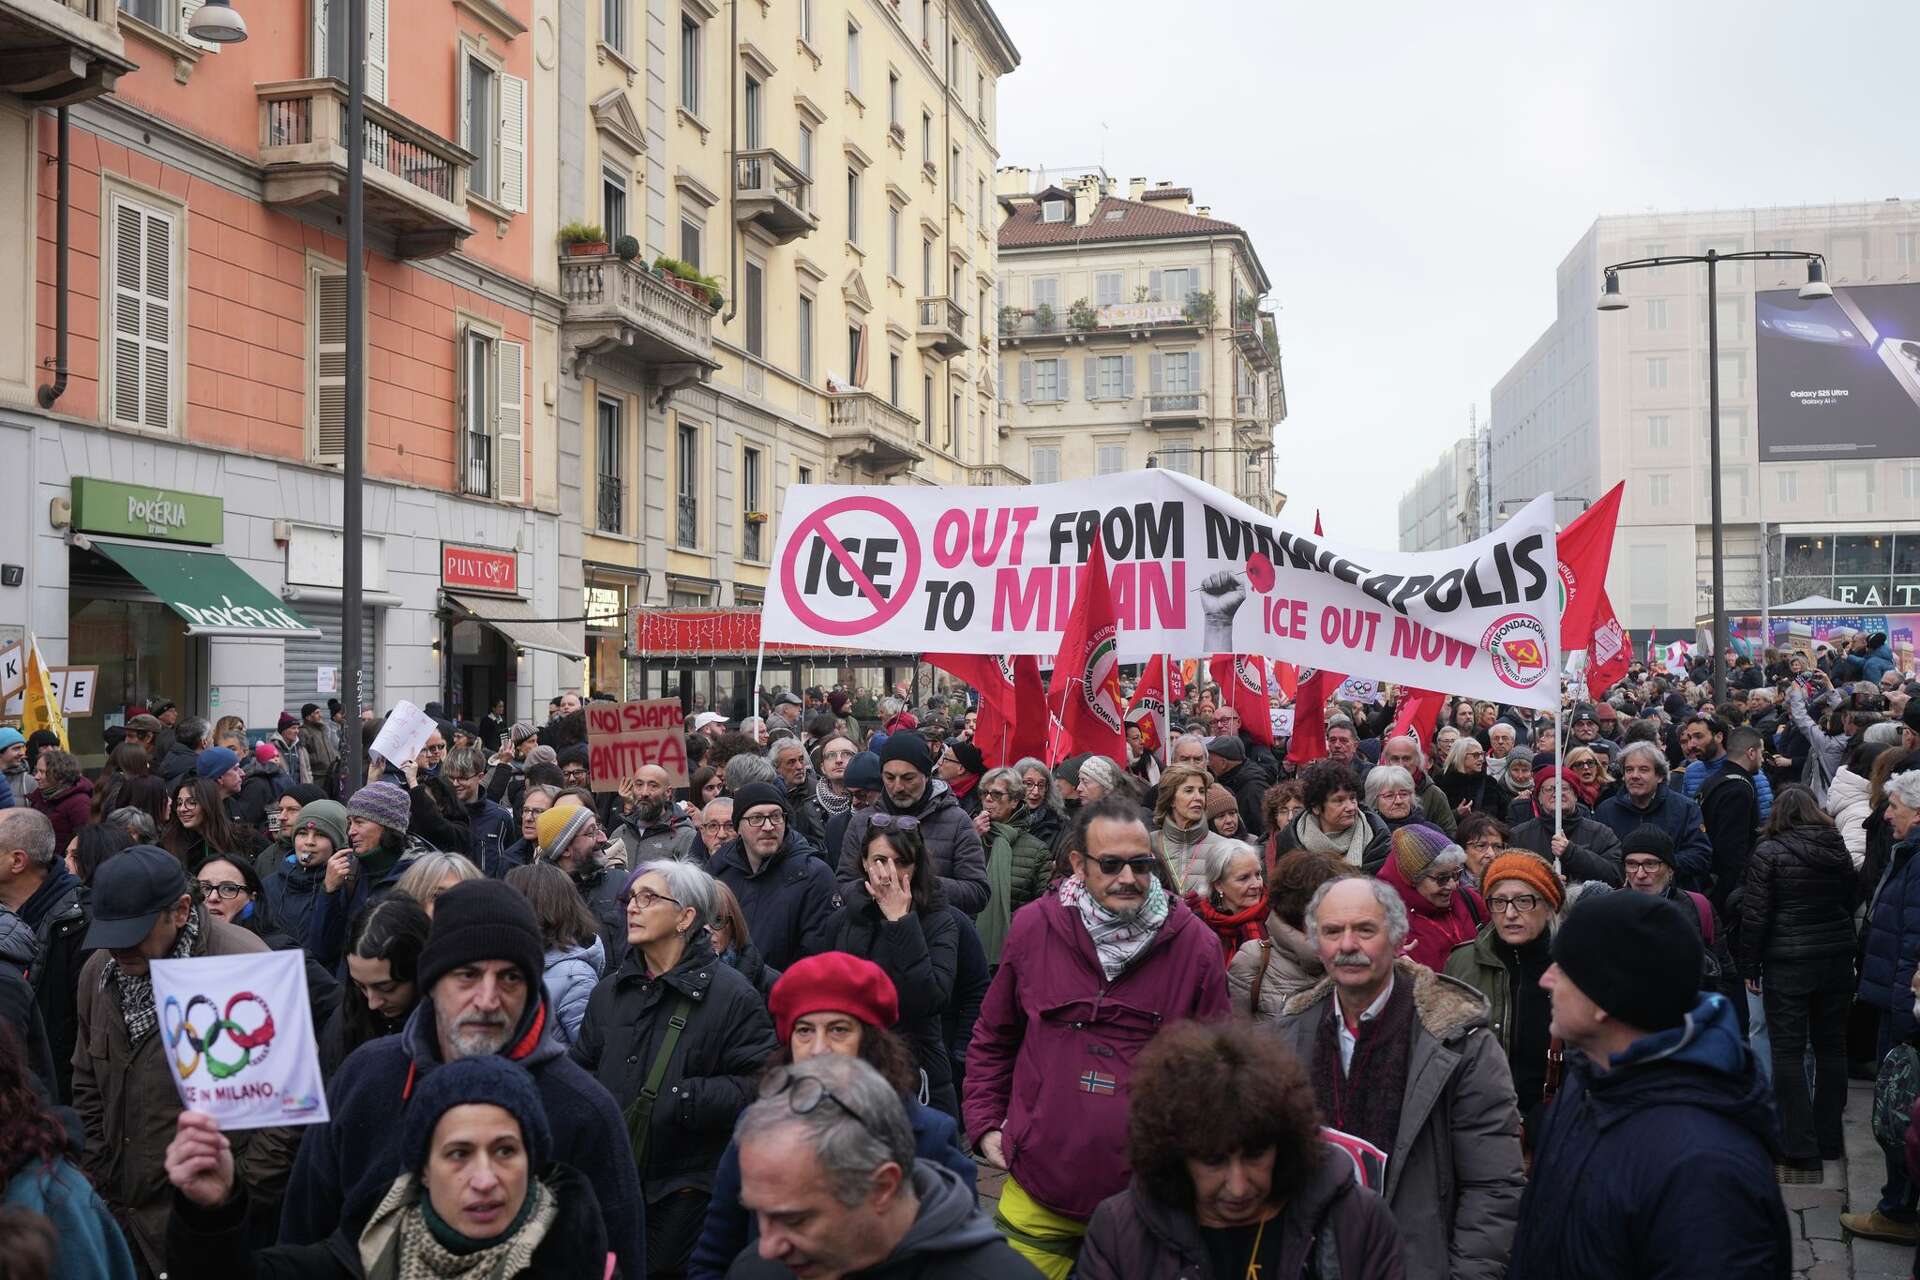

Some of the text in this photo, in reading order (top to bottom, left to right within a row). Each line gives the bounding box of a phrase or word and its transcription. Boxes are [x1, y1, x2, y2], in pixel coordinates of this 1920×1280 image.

[1790, 390, 1817, 398] Galaxy
[933, 506, 1039, 568] OUT
[1050, 501, 1184, 564] FROM
[448, 557, 493, 580] PUNTO
[804, 536, 898, 599] ICE
[924, 580, 975, 631] TO
[1263, 596, 1477, 669] ICE OUT NOW
[6, 659, 17, 678] K
[590, 704, 684, 734] NOI SIAMO
[590, 735, 687, 781] ANTIFA
[201, 1089, 211, 1100] IN
